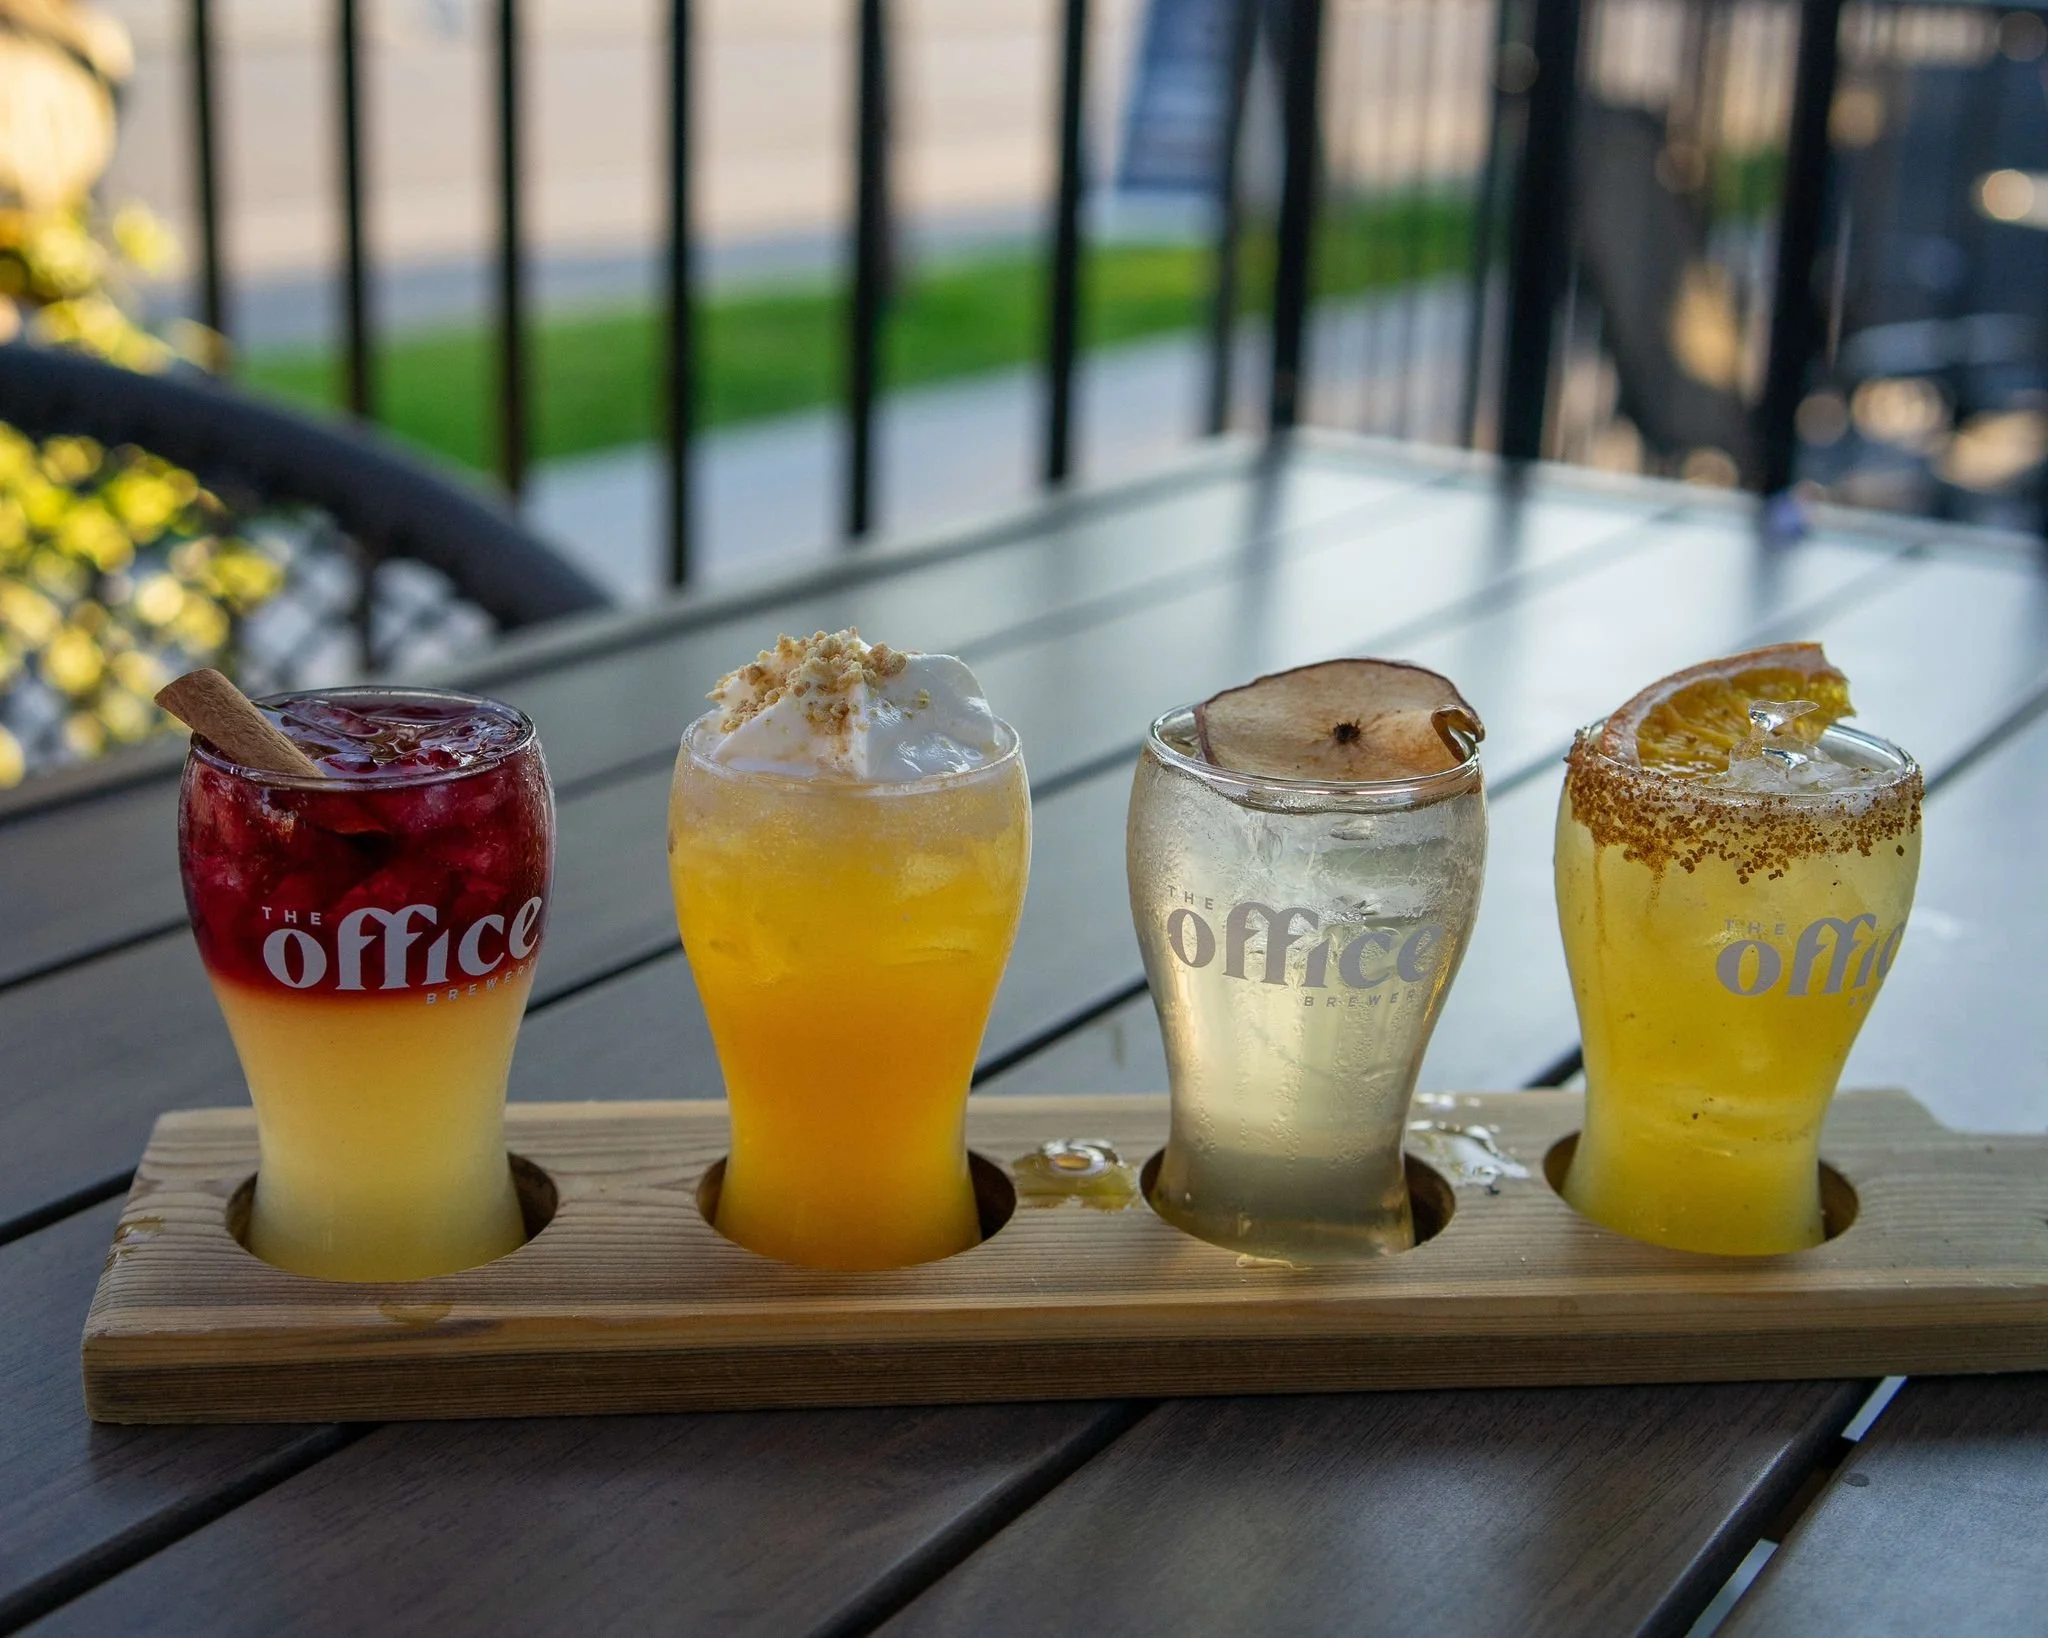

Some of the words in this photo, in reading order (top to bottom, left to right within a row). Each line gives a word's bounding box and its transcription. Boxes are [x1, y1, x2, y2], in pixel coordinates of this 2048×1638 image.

[1167, 885, 1214, 910] THE
[261, 906, 322, 926] THE
[1724, 918, 1787, 937] THE
[262, 896, 543, 990] office
[1166, 901, 1443, 990] office
[1303, 984, 1431, 1008] BREWER
